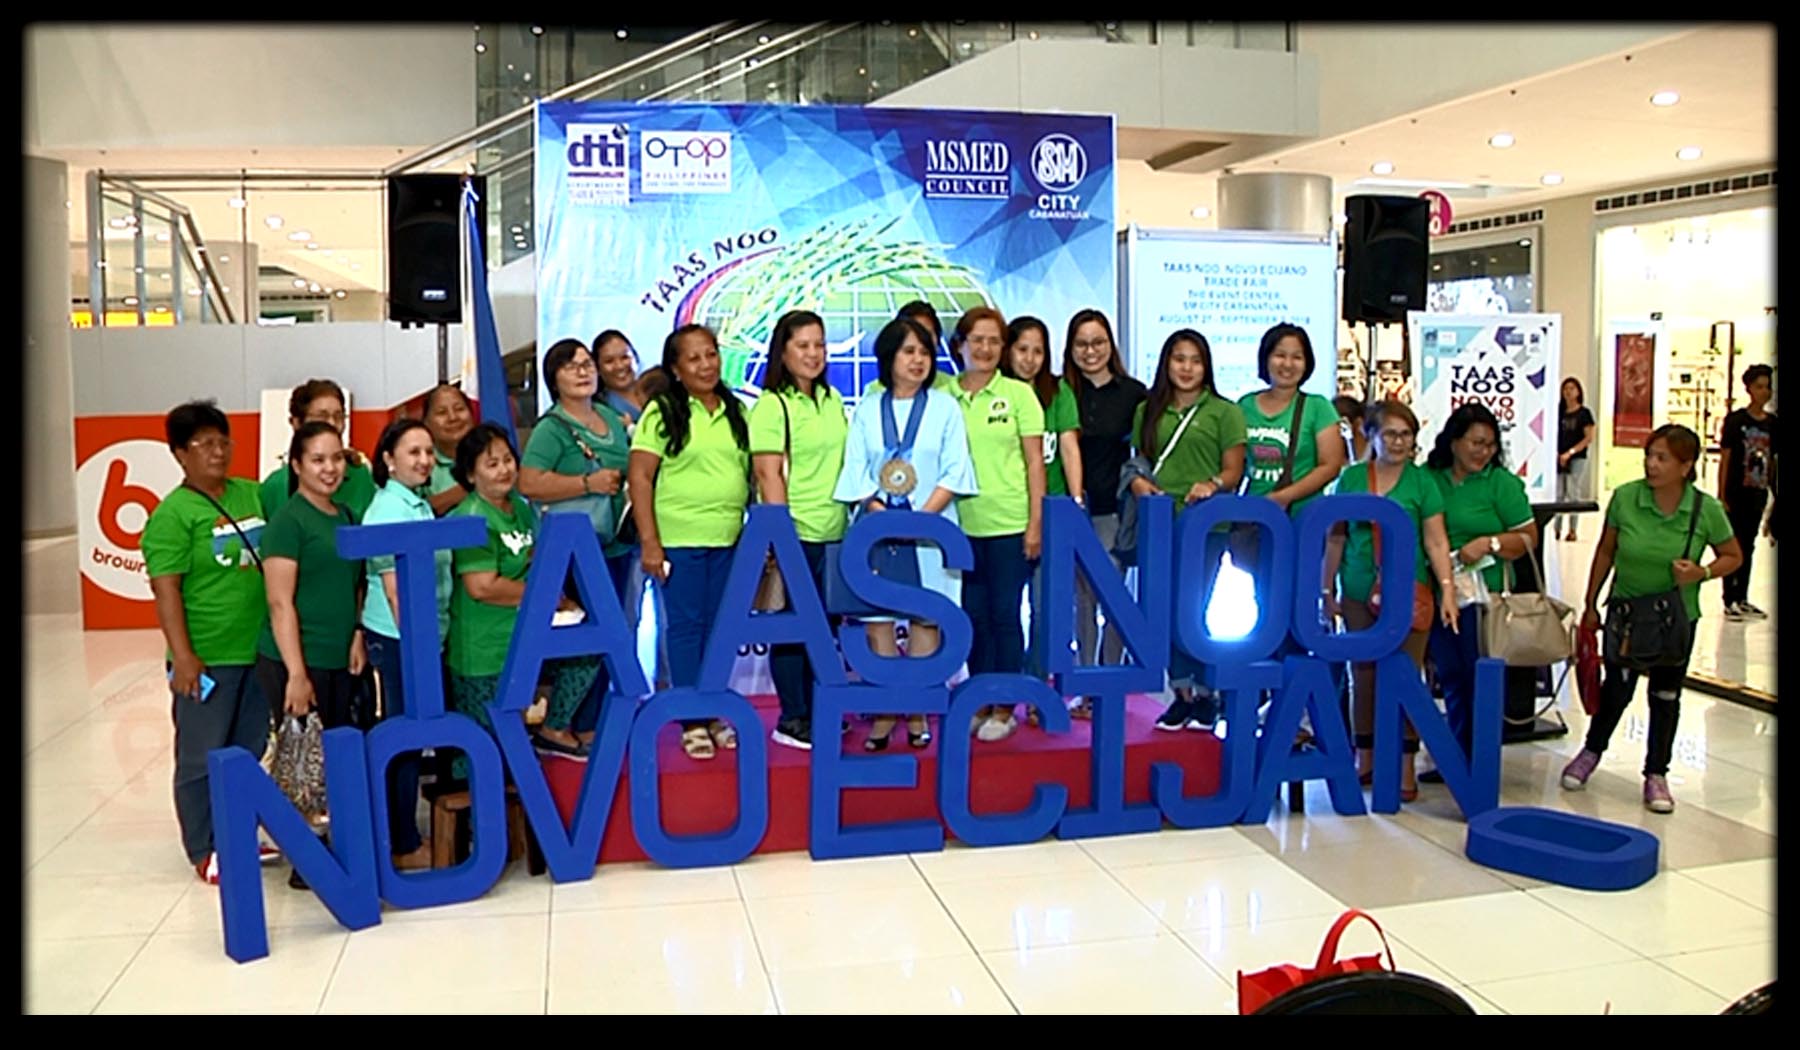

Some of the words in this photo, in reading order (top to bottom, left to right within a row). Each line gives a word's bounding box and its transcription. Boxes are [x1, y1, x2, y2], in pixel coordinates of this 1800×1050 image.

[568, 128, 627, 167] dti
[926, 140, 1009, 172] MSMED
[1038, 141, 1079, 183] SM
[926, 179, 1009, 193] COUNCIL
[1038, 194, 1080, 210] CITY
[641, 252, 707, 313] TAAS
[714, 228, 777, 260] NOO
[1163, 262, 1191, 273] TAAS
[1204, 277, 1239, 287] TRADE
[1451, 365, 1515, 380] TAAS
[1451, 380, 1515, 393] NOO
[1451, 396, 1514, 409] NOVO
[336, 504, 974, 722] TAAS
[1041, 494, 1415, 676] NOO
[207, 684, 770, 964] NOVO
